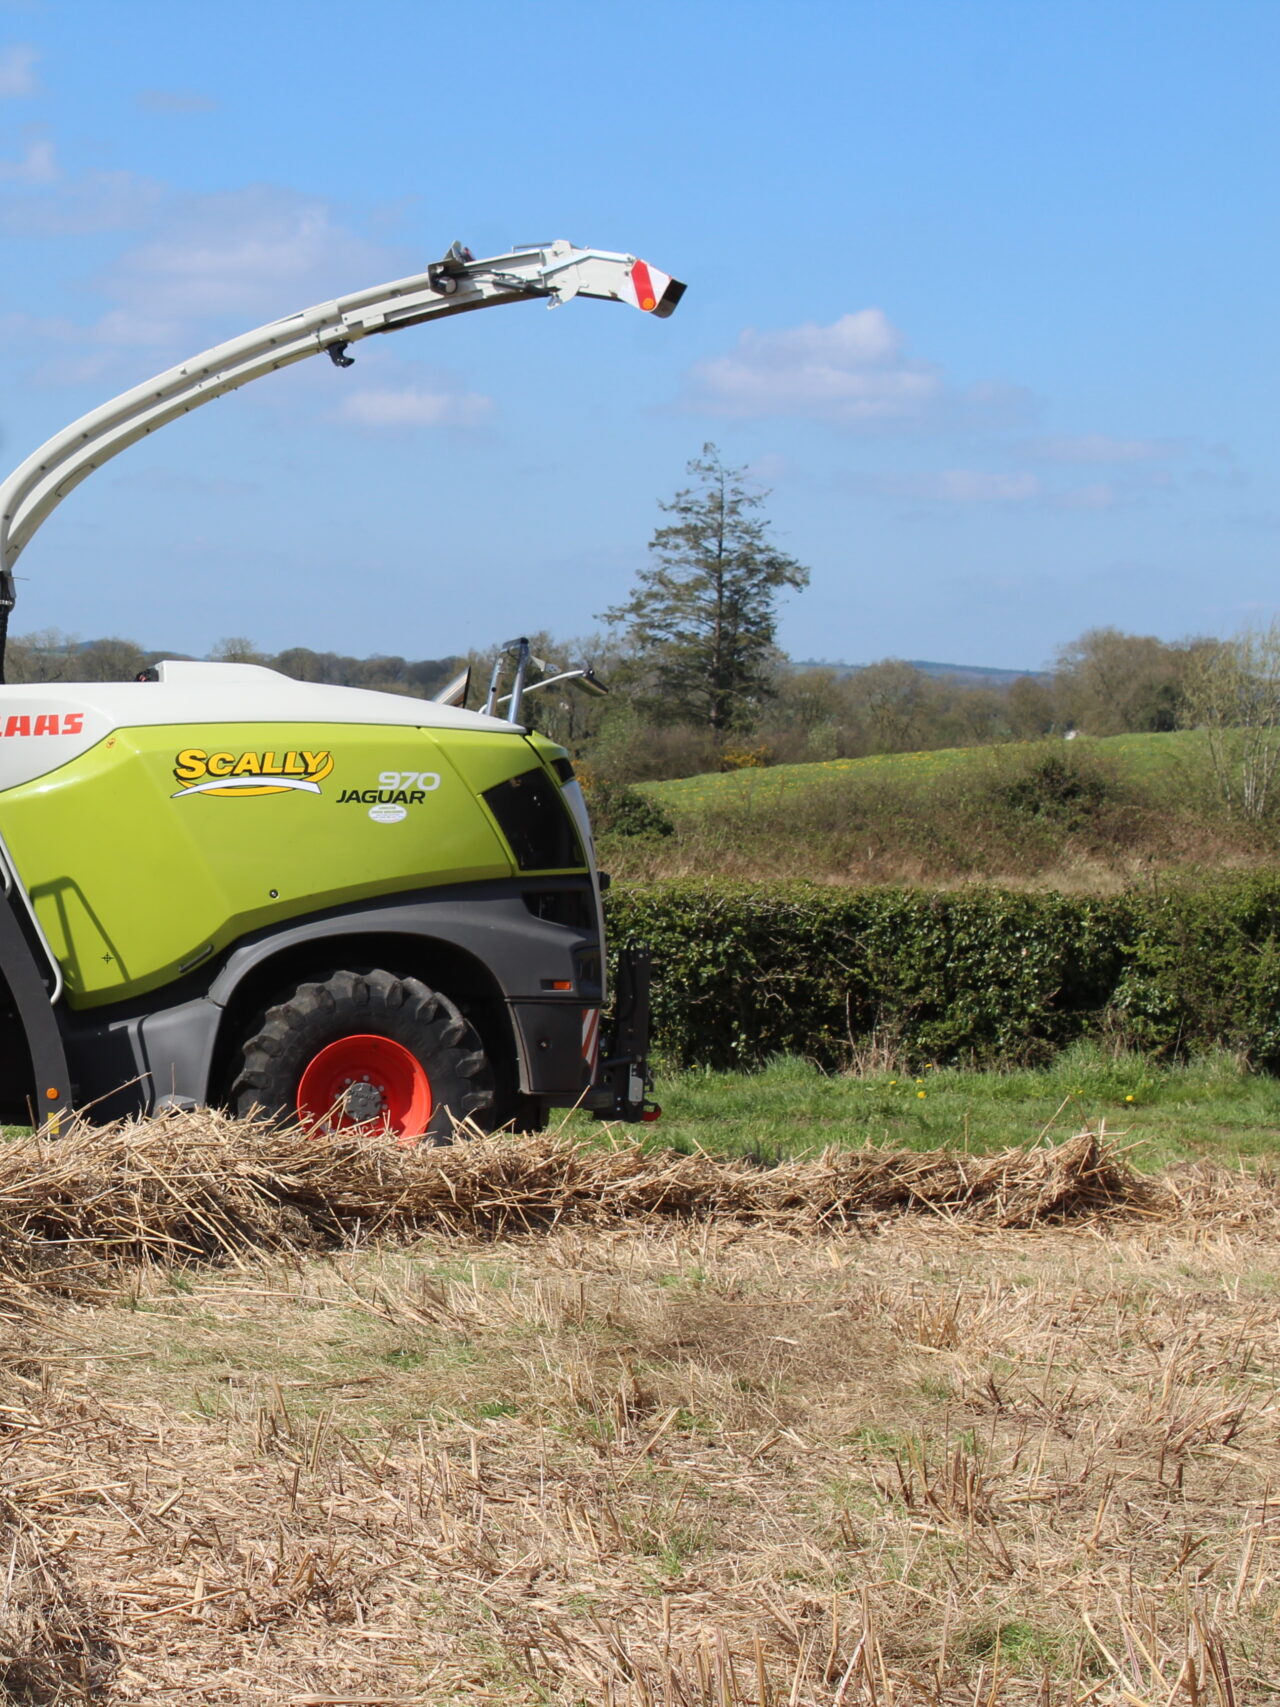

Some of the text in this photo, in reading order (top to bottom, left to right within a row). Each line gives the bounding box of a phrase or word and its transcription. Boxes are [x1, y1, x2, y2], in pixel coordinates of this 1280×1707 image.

[173, 749, 330, 781] SCALLY
[378, 771, 441, 791] 970
[336, 789, 426, 804] JAGUAR
